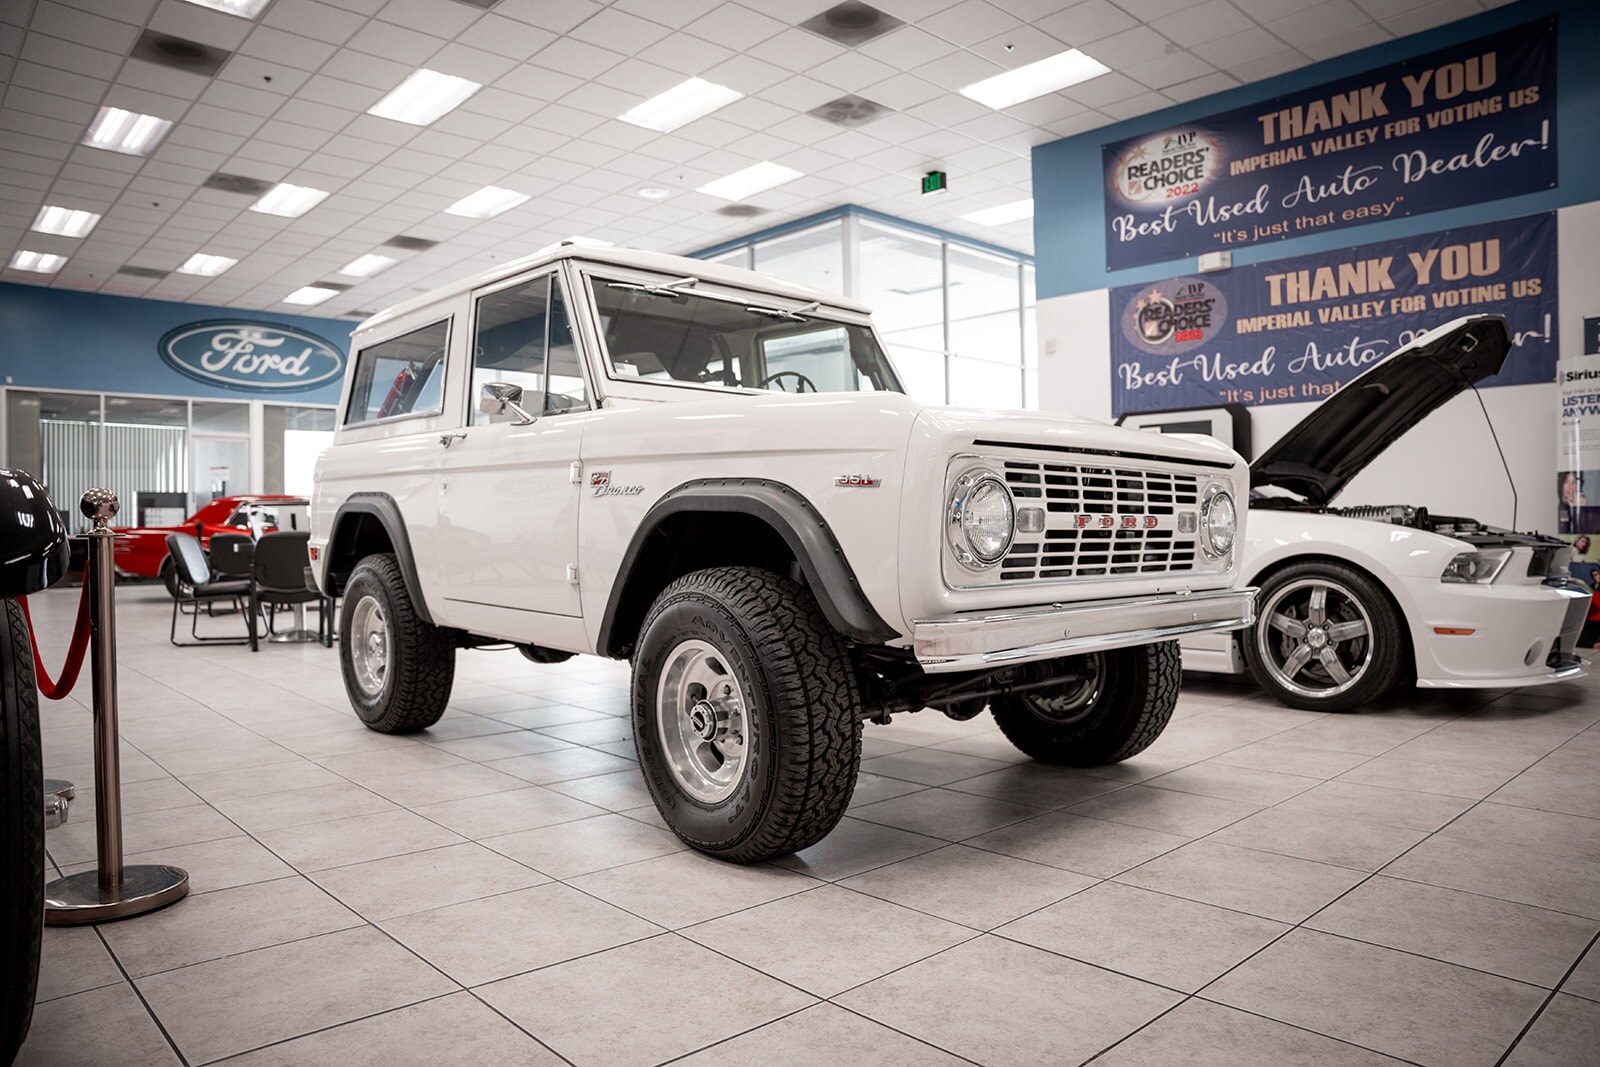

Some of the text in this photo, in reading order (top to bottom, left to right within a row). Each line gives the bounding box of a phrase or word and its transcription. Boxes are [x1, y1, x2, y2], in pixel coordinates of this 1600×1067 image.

[1258, 51, 1497, 145] THANK YOU
[1230, 145, 1307, 176] IMPERIAL
[1311, 125, 1379, 158] VALLEY
[1384, 118, 1421, 141] FOR
[1427, 96, 1503, 128] VOTING
[1509, 86, 1540, 109] US
[1112, 119, 1550, 243] Best Used Auto Dealer!
[1127, 147, 1210, 180] READERS'
[1143, 164, 1204, 191] CHOICE
[1166, 182, 1199, 198] 2022
[1253, 219, 1289, 243] just
[1294, 212, 1336, 232] that
[1342, 196, 1404, 227] easy"
[1265, 238, 1500, 306] THANK YOU
[1158, 313, 1211, 333] CHOICE
[1236, 278, 1542, 335] IMPERIAL VALLEY FOR VOTING US
[200, 332, 313, 377] Ford
[1118, 335, 1390, 390] Best Used Auto
[1260, 384, 1295, 404] just
[1302, 380, 1341, 397] that
[591, 478, 645, 497] Bronco
[1073, 514, 1159, 529] FORD
